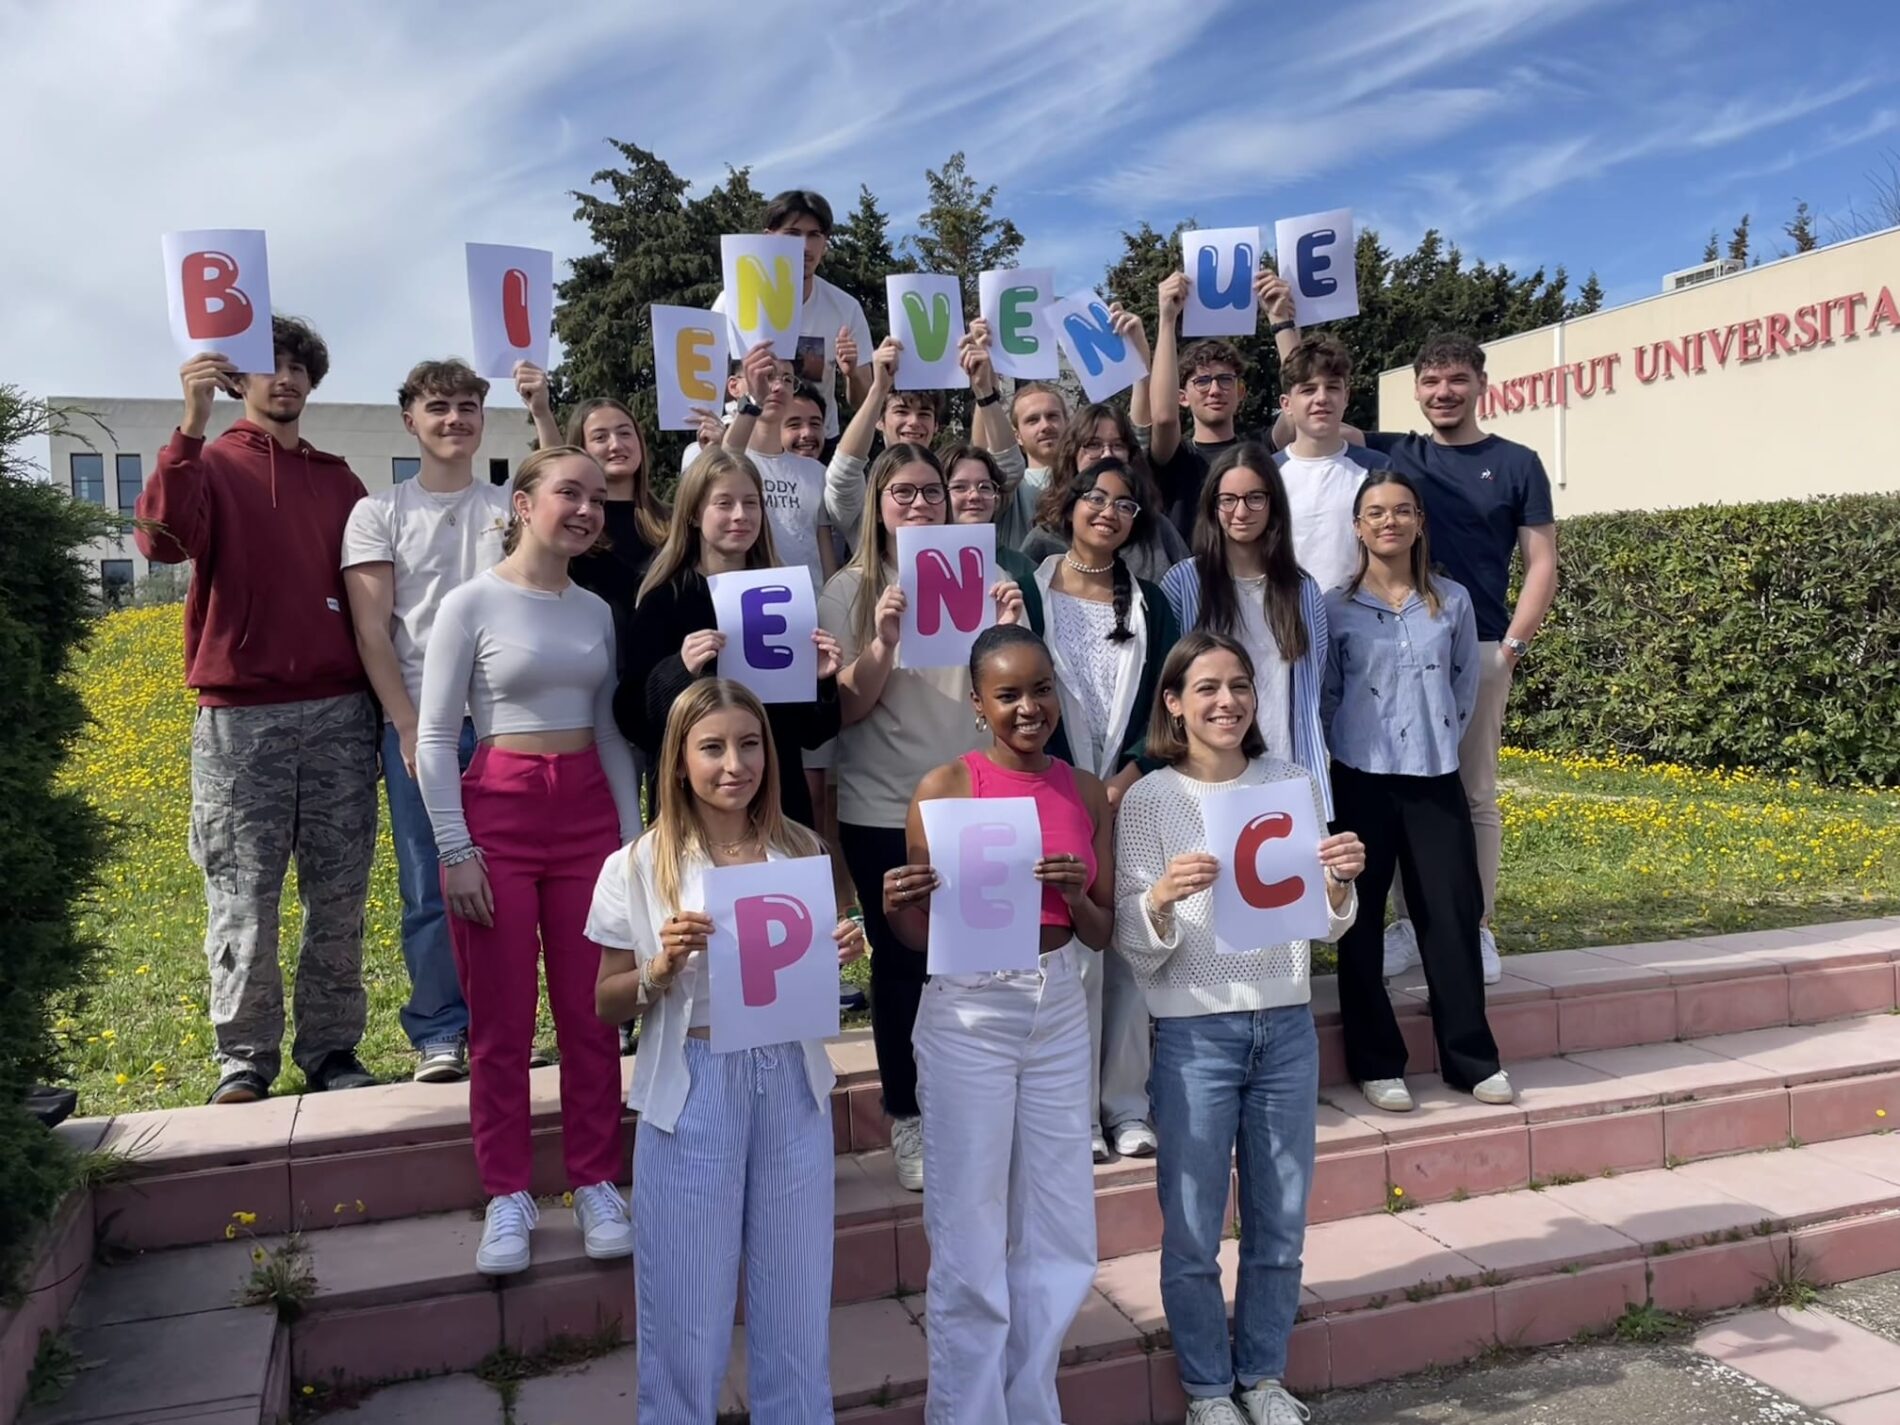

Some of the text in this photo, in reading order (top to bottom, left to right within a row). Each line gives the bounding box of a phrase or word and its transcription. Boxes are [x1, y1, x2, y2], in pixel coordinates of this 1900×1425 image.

[182, 251, 254, 339] B
[736, 256, 794, 329] N
[1197, 243, 1253, 310] U
[1297, 229, 1338, 298] E
[503, 269, 531, 348] I
[902, 291, 950, 362] V
[1000, 286, 1039, 355] E
[1064, 301, 1126, 376] N
[676, 327, 717, 401] E
[1478, 353, 1620, 418] INSTITUT
[741, 586, 794, 670] E
[916, 546, 984, 636] N
[958, 822, 1017, 930] E
[1234, 811, 1305, 909] C
[735, 893, 813, 1007] P
